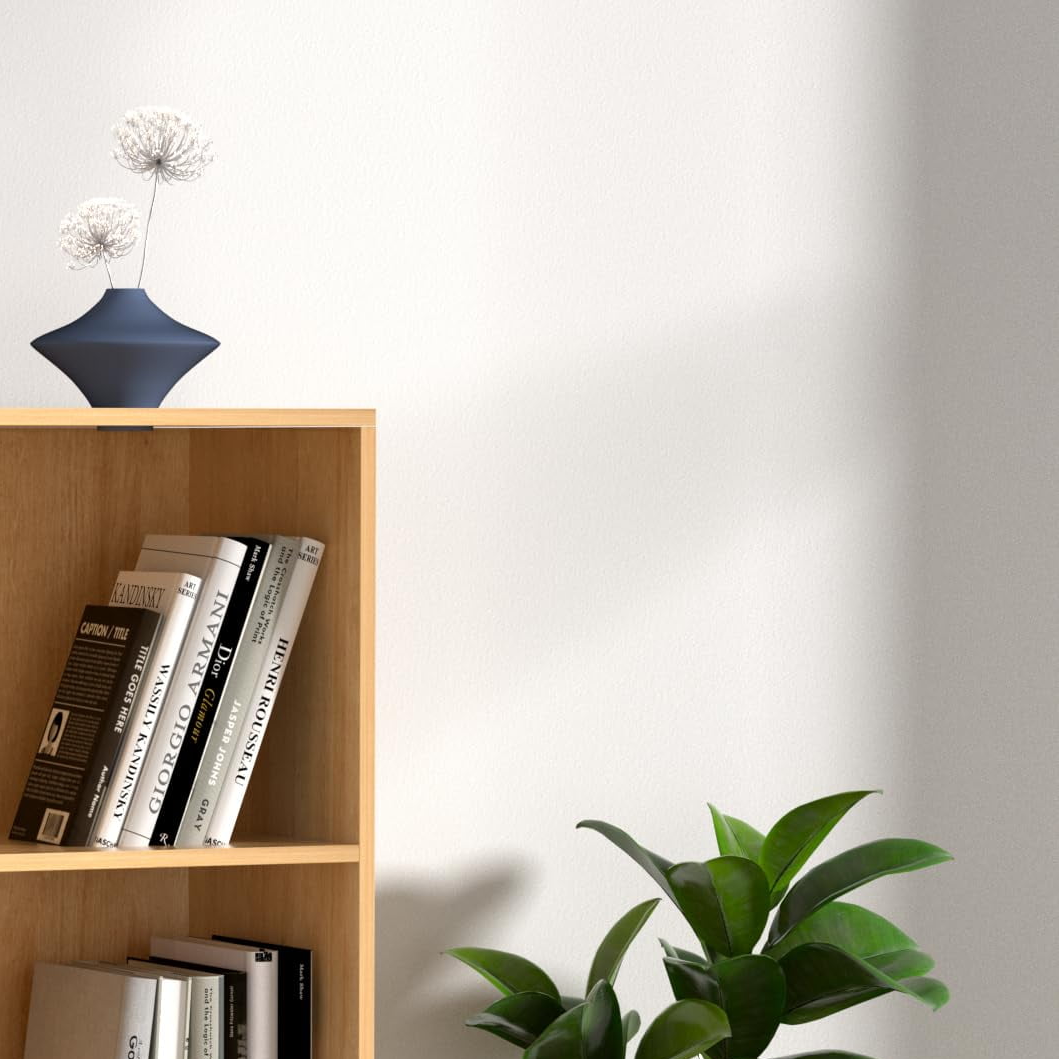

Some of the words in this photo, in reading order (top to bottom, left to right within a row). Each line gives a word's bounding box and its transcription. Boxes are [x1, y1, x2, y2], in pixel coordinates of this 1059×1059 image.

[298, 552, 319, 566] SERIES
[305, 545, 319, 555] ART
[110, 583, 165, 608] KANDINSKY
[184, 581, 196, 591] ART
[80, 622, 109, 637] CAPTION
[113, 626, 130, 640] TITLE
[135, 645, 149, 671] TITLE
[210, 642, 233, 679] Dior
[265, 638, 289, 690] HENRI
[123, 673, 139, 705] GOES
[142, 664, 170, 730] WASSILY
[148, 703, 191, 814] GIORGIO
[188, 589, 229, 696] ARMANI
[114, 706, 129, 734] HERE
[193, 687, 216, 744] Glamour
[222, 699, 242, 744] JASPER
[234, 695, 271, 787] ROUSSEAU
[97, 765, 109, 792] Author
[113, 732, 148, 819] KANDINSKY
[207, 746, 227, 786] JOHNS
[87, 794, 100, 818] Name
[193, 799, 209, 832] GRAY
